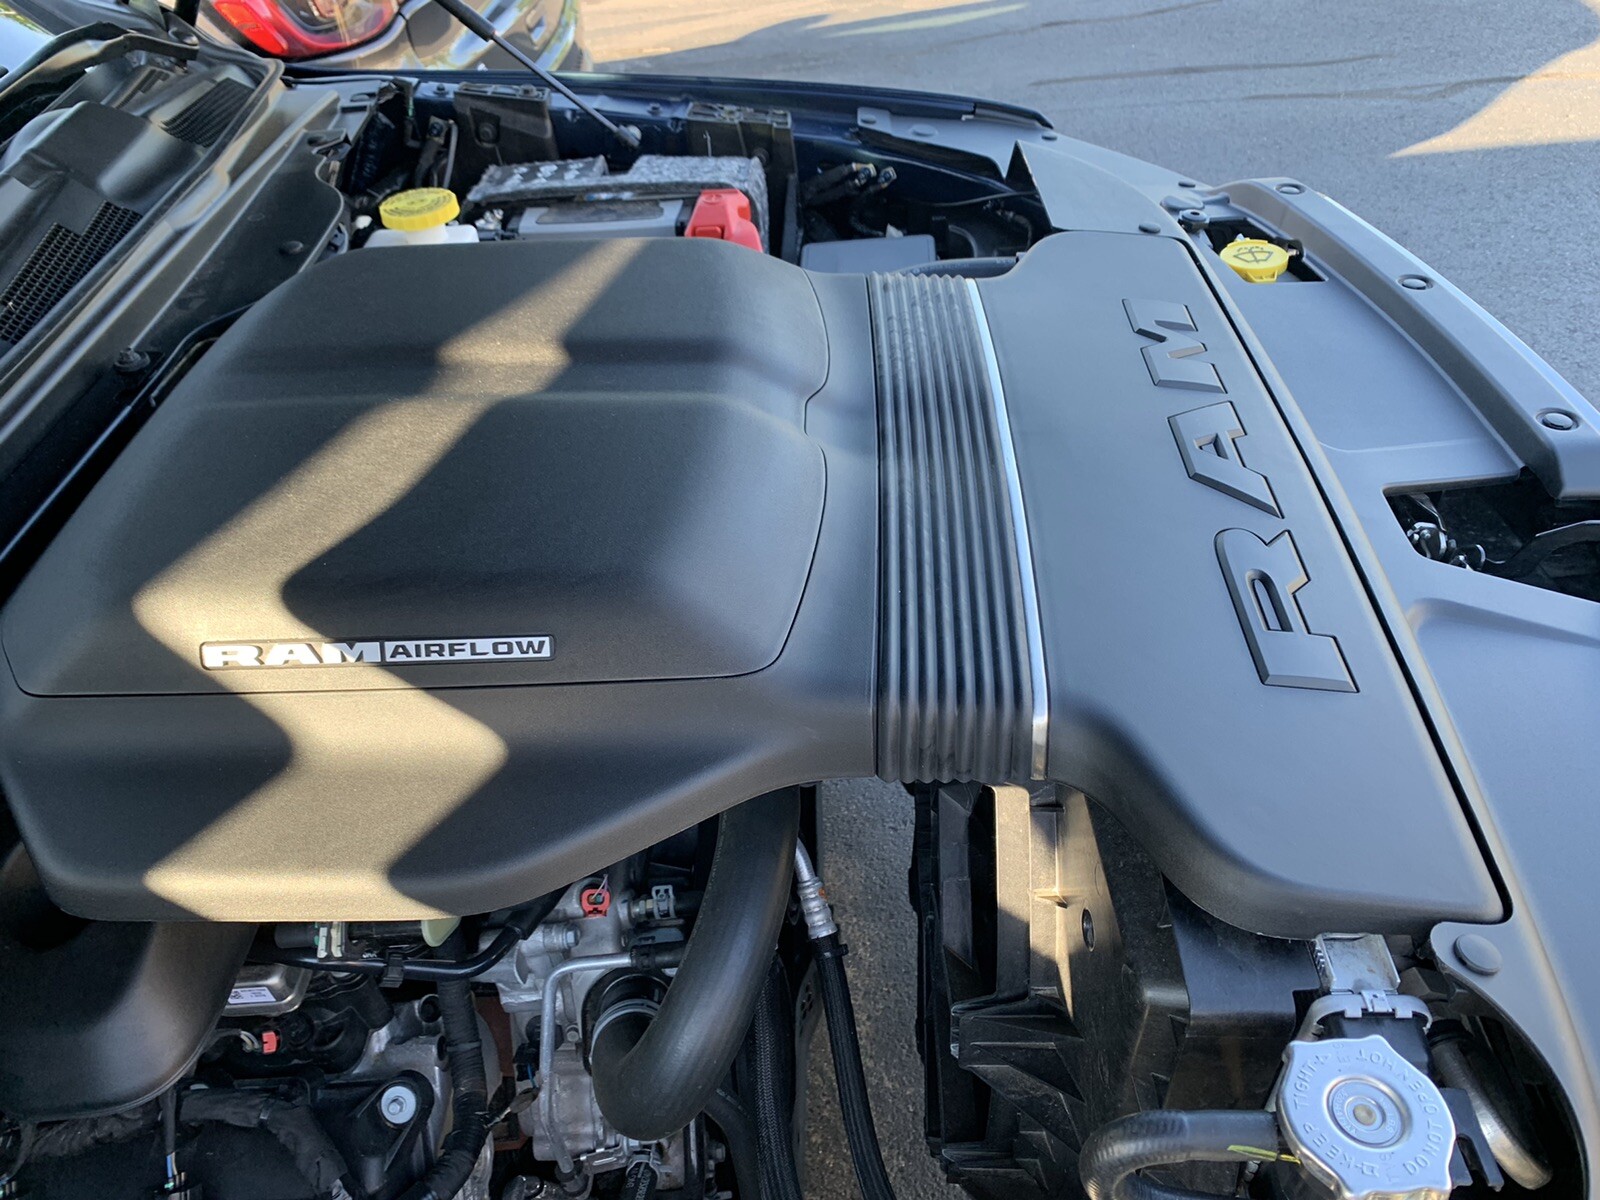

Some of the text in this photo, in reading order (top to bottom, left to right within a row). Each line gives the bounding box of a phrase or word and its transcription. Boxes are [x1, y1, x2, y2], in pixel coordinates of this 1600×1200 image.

[1122, 299, 1360, 693] RAM
[202, 639, 546, 668] RAM AIRFLOW
[1293, 1059, 1318, 1111] TIGHT
[1356, 1049, 1444, 1177] DO NOT OPEN HOT
[1303, 1122, 1354, 1169] KEEP
